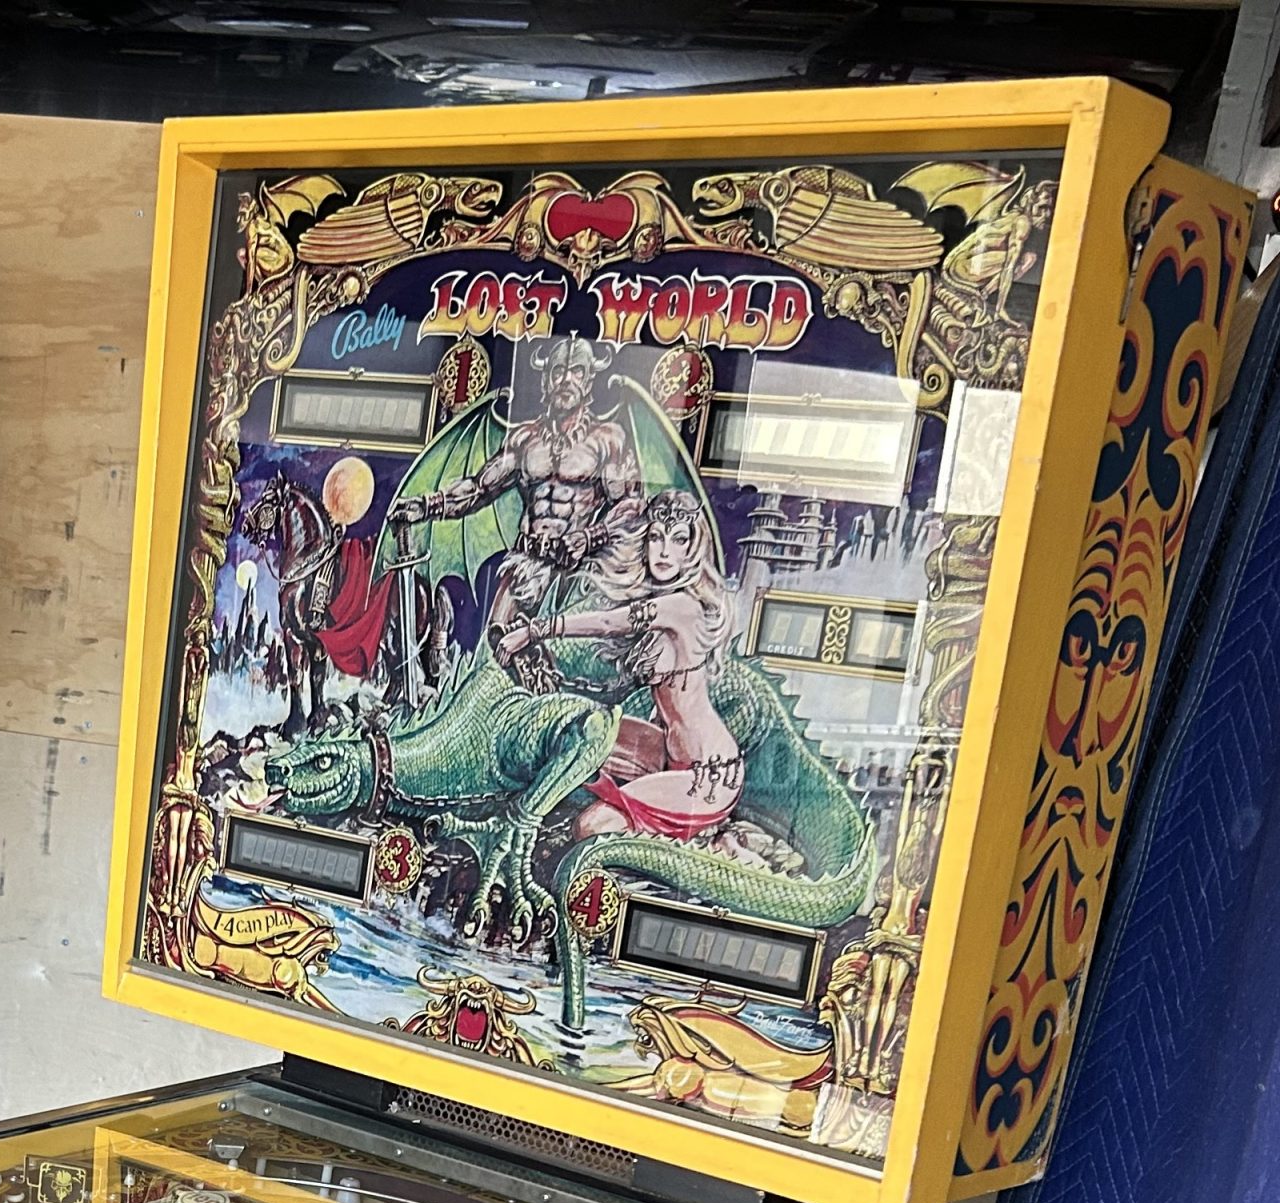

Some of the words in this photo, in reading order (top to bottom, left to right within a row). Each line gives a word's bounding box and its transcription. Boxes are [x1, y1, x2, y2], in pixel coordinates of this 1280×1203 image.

[331, 302, 407, 360] Bally
[418, 269, 568, 346] LOST
[588, 267, 816, 354] WORLD
[452, 350, 472, 405] 1
[663, 350, 705, 410] 2
[766, 644, 805, 656] CREDIT
[380, 835, 411, 884] 3
[236, 917, 264, 935] can
[265, 910, 297, 933] play
[571, 876, 605, 928] 4
